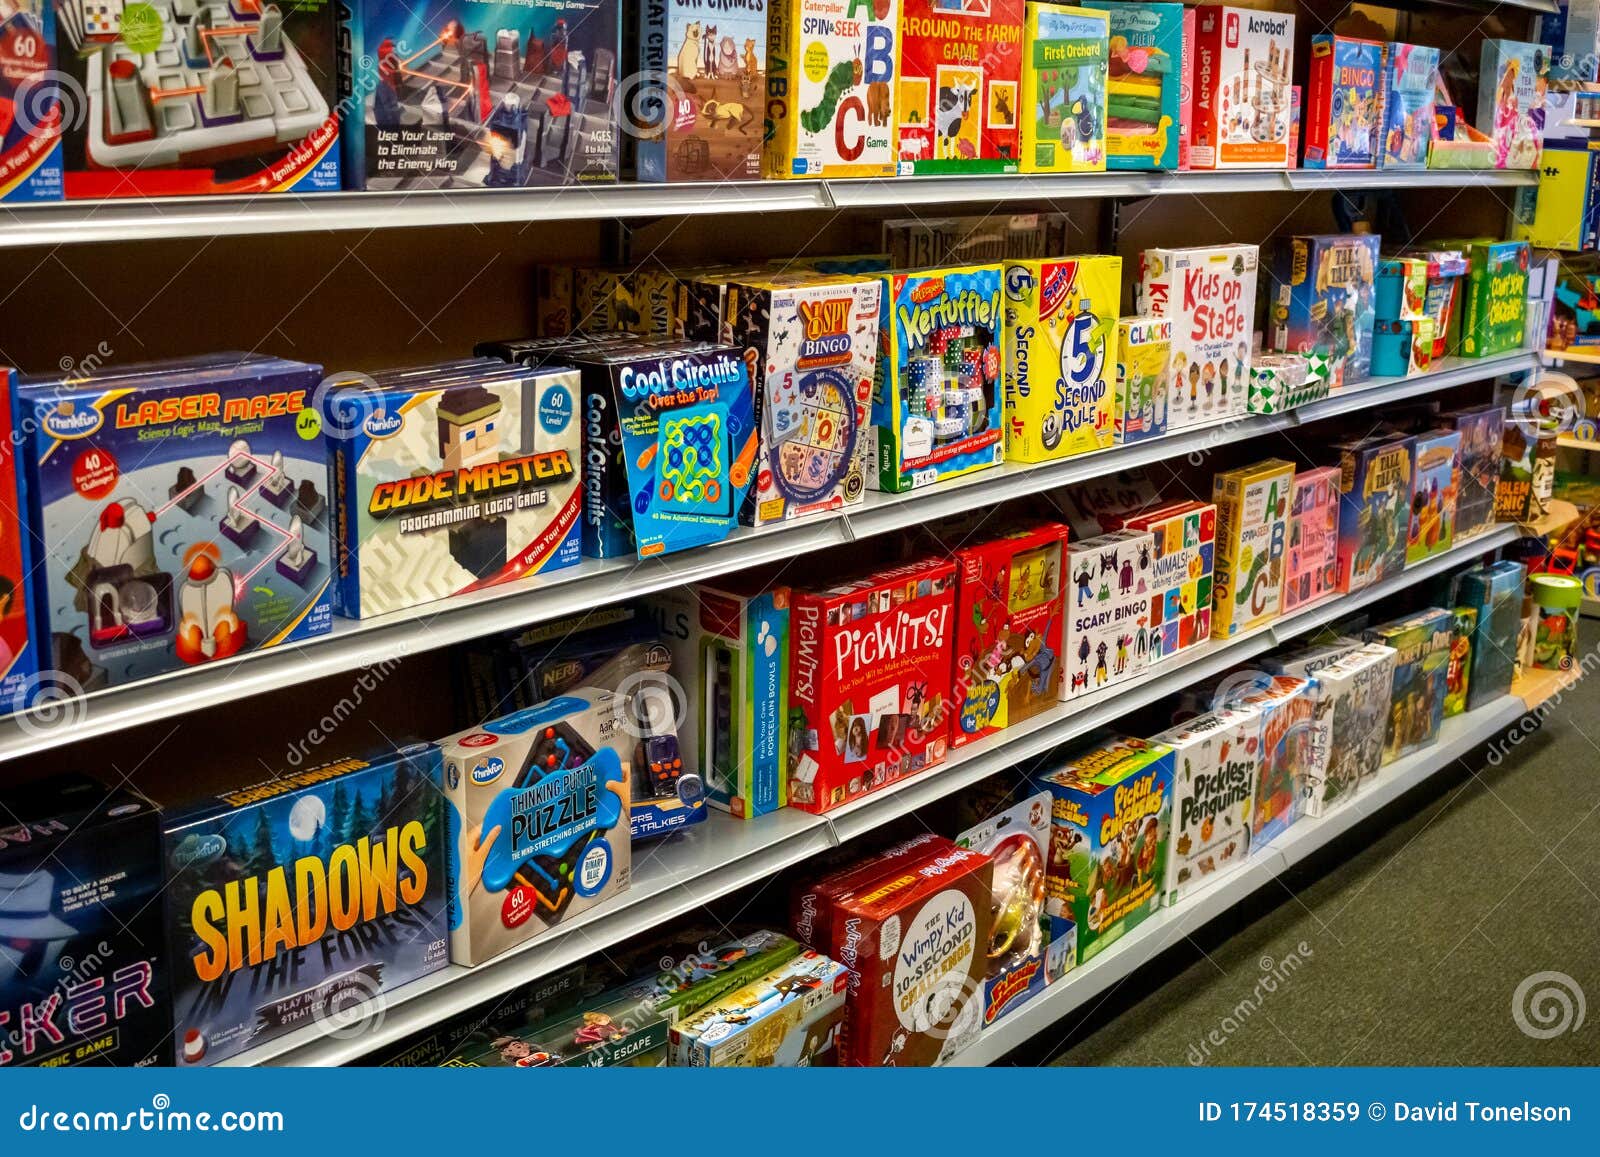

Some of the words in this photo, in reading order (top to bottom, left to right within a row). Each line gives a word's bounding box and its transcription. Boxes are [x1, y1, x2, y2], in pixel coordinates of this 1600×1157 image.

[901, 16, 961, 40] AROUND
[963, 25, 983, 42] THE
[986, 24, 1020, 44] FARM
[14, 35, 36, 57] 60
[943, 43, 979, 61] GAME
[1044, 45, 1065, 61] First
[1066, 42, 1100, 58] Orchard
[1340, 66, 1376, 87] BINGO
[678, 98, 691, 115] 40
[377, 130, 399, 142] Use
[402, 130, 424, 142] Your
[426, 130, 456, 142] Laser
[591, 130, 612, 142] AGES
[866, 135, 888, 149] Game
[377, 145, 389, 155] to
[391, 145, 438, 156] Eliminate
[272, 162, 296, 181] Ignite
[294, 147, 314, 165] Your
[377, 158, 395, 170] the
[397, 158, 432, 172] Enemy
[435, 158, 458, 171] King
[1044, 266, 1058, 286] Just
[1183, 266, 1220, 312] Kids
[1222, 278, 1242, 305] on
[823, 298, 853, 334] SPY
[898, 289, 1000, 351] Kerfuffle!
[1191, 303, 1245, 342] Stage
[1130, 322, 1171, 344] CLACK!
[805, 337, 850, 356] BINGO
[1070, 317, 1097, 383] 5
[620, 362, 669, 398] Cool
[671, 354, 740, 391] Circuits
[783, 372, 793, 390] 5
[550, 393, 564, 407] 60
[648, 391, 677, 409] Over
[678, 389, 695, 405] the
[695, 384, 720, 404] Top!
[1054, 378, 1106, 410] SECOND
[116, 393, 221, 430] LASER
[222, 390, 307, 424] MAZE
[298, 415, 320, 430] Jr.
[588, 393, 607, 443] Cool
[1062, 406, 1096, 432] RULE
[1095, 411, 1110, 431] Jr.
[137, 426, 168, 442] Science
[172, 422, 195, 439] Logic
[197, 420, 220, 433] Maze
[233, 421, 264, 438] Juniors!
[84, 454, 100, 470] 40
[882, 444, 891, 472] Family
[369, 471, 454, 516] CODE
[457, 450, 575, 494] MASTER
[588, 447, 607, 526] Circuits
[1501, 481, 1531, 496] BLEM
[400, 502, 480, 534] PROGRAMMING
[485, 497, 514, 515] LOGIC
[517, 490, 547, 507] GAME
[673, 515, 699, 523] Advanced
[700, 515, 730, 526] Challenges!
[524, 542, 546, 565] Ignite
[542, 524, 560, 545] Your
[558, 498, 576, 528] Mind!
[566, 538, 579, 547] AGES
[312, 604, 330, 615] AGES
[323, 614, 331, 625] up
[1075, 610, 1112, 633] SCARY
[1114, 600, 1148, 623] BINGO
[543, 663, 580, 688] NERF
[768, 660, 776, 698] BOWLS
[851, 677, 865, 690] Your
[866, 671, 876, 684] Wit
[884, 661, 899, 675] Make
[900, 658, 911, 668] the
[759, 720, 767, 741] Your
[767, 699, 776, 757] PORCELAIN
[511, 779, 560, 814] THINKING
[563, 765, 594, 789] PUTTY
[1193, 760, 1246, 799] Pickles
[1113, 771, 1157, 815] Pickin'
[1180, 773, 1254, 832] Penguins!
[511, 784, 598, 852] PUZZLE
[641, 815, 686, 833] TALKIES
[1099, 786, 1164, 847] Chickens
[511, 851, 521, 861] THE
[572, 824, 585, 836] LOGIC
[585, 818, 597, 830] GAME
[584, 858, 604, 871] BINARY
[586, 868, 600, 881] BLUE
[191, 820, 429, 982] SHADOWS
[511, 889, 524, 908] 60
[903, 929, 944, 968] Wimpy
[945, 901, 966, 934] Kid
[924, 912, 942, 932] THE
[427, 939, 446, 952] AGES
[896, 921, 973, 998] 10-SECOND
[899, 940, 972, 1013] CHALLENGE
[277, 1000, 302, 1014] PLAY
[304, 994, 315, 1007] IN
[498, 999, 527, 1018] SOLVE
[535, 978, 570, 1001] ESCAPE
[76, 1035, 114, 1059] GAME
[614, 1035, 652, 1061] ESCAPE
